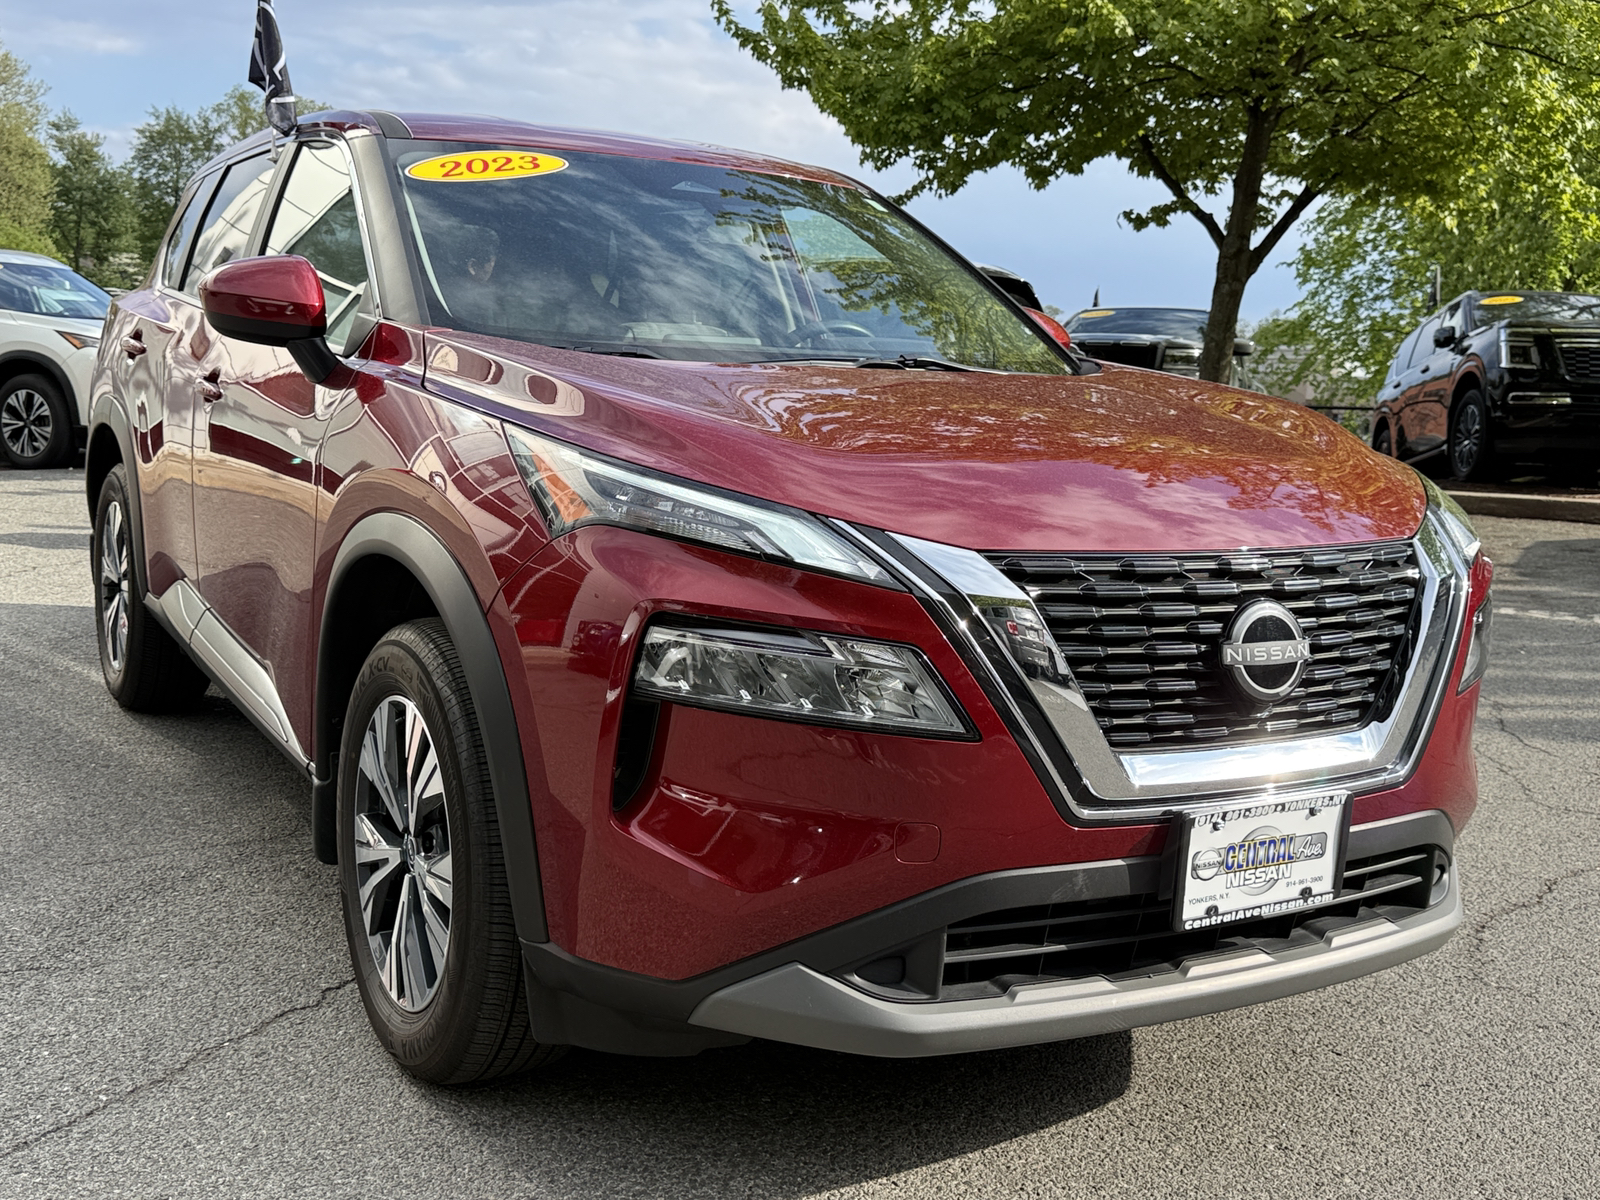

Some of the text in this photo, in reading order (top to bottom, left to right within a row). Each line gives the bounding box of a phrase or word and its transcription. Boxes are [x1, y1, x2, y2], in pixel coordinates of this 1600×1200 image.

[439, 155, 541, 178] 2023
[1226, 643, 1308, 663] NISSAN
[1223, 833, 1324, 874] CENTRAL Ave.
[1195, 860, 1221, 869] NISSAN
[1225, 863, 1293, 889] NISSAN
[1285, 875, 1324, 888] 914-961-3900
[1188, 894, 1218, 906] YONKERS,
[1184, 892, 1334, 931] CentralAveNissan.com
